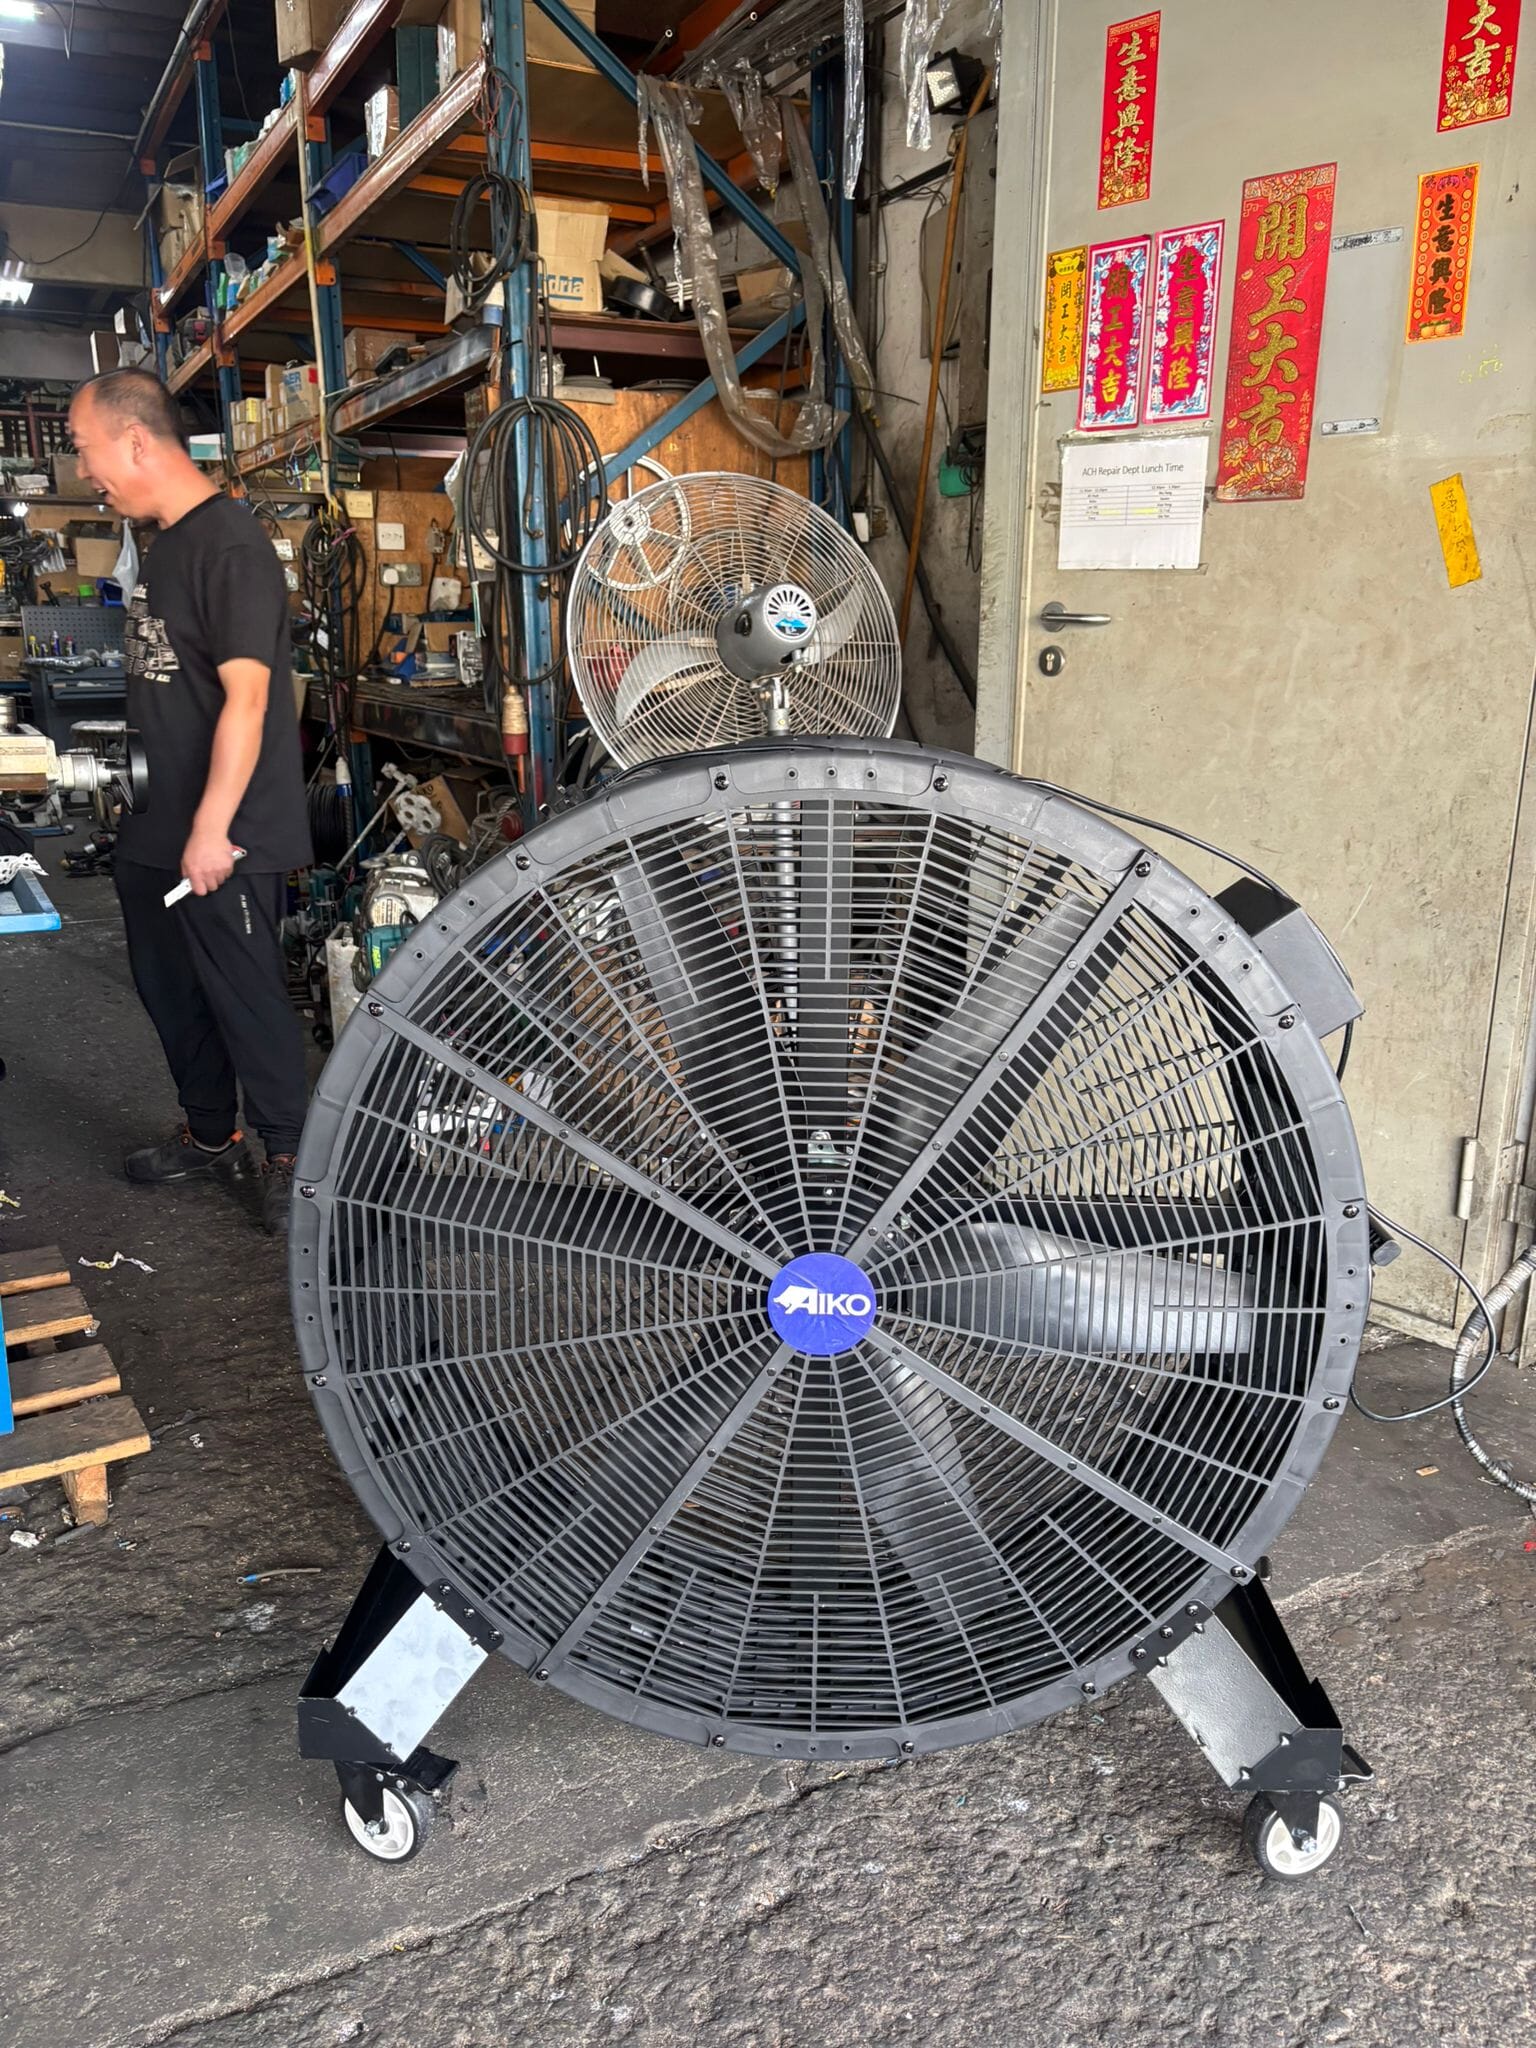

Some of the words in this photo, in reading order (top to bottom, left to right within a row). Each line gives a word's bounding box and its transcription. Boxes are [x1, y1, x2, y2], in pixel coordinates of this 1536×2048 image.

[1110, 31, 1147, 171] 生意興隆
[1427, 192, 1456, 316] 生意興隆
[1058, 279, 1073, 365] 開工大吉
[1102, 259, 1130, 403] 開工大吉
[1167, 250, 1199, 391] 生意興隆
[1238, 193, 1309, 448] 開工大吉
[1082, 467, 1097, 476] ACH
[1098, 465, 1121, 477] Repair
[1122, 465, 1140, 475] Dept
[1141, 463, 1164, 474] Lunch
[1165, 462, 1184, 473] Time
[773, 1284, 872, 1317] AIKO
